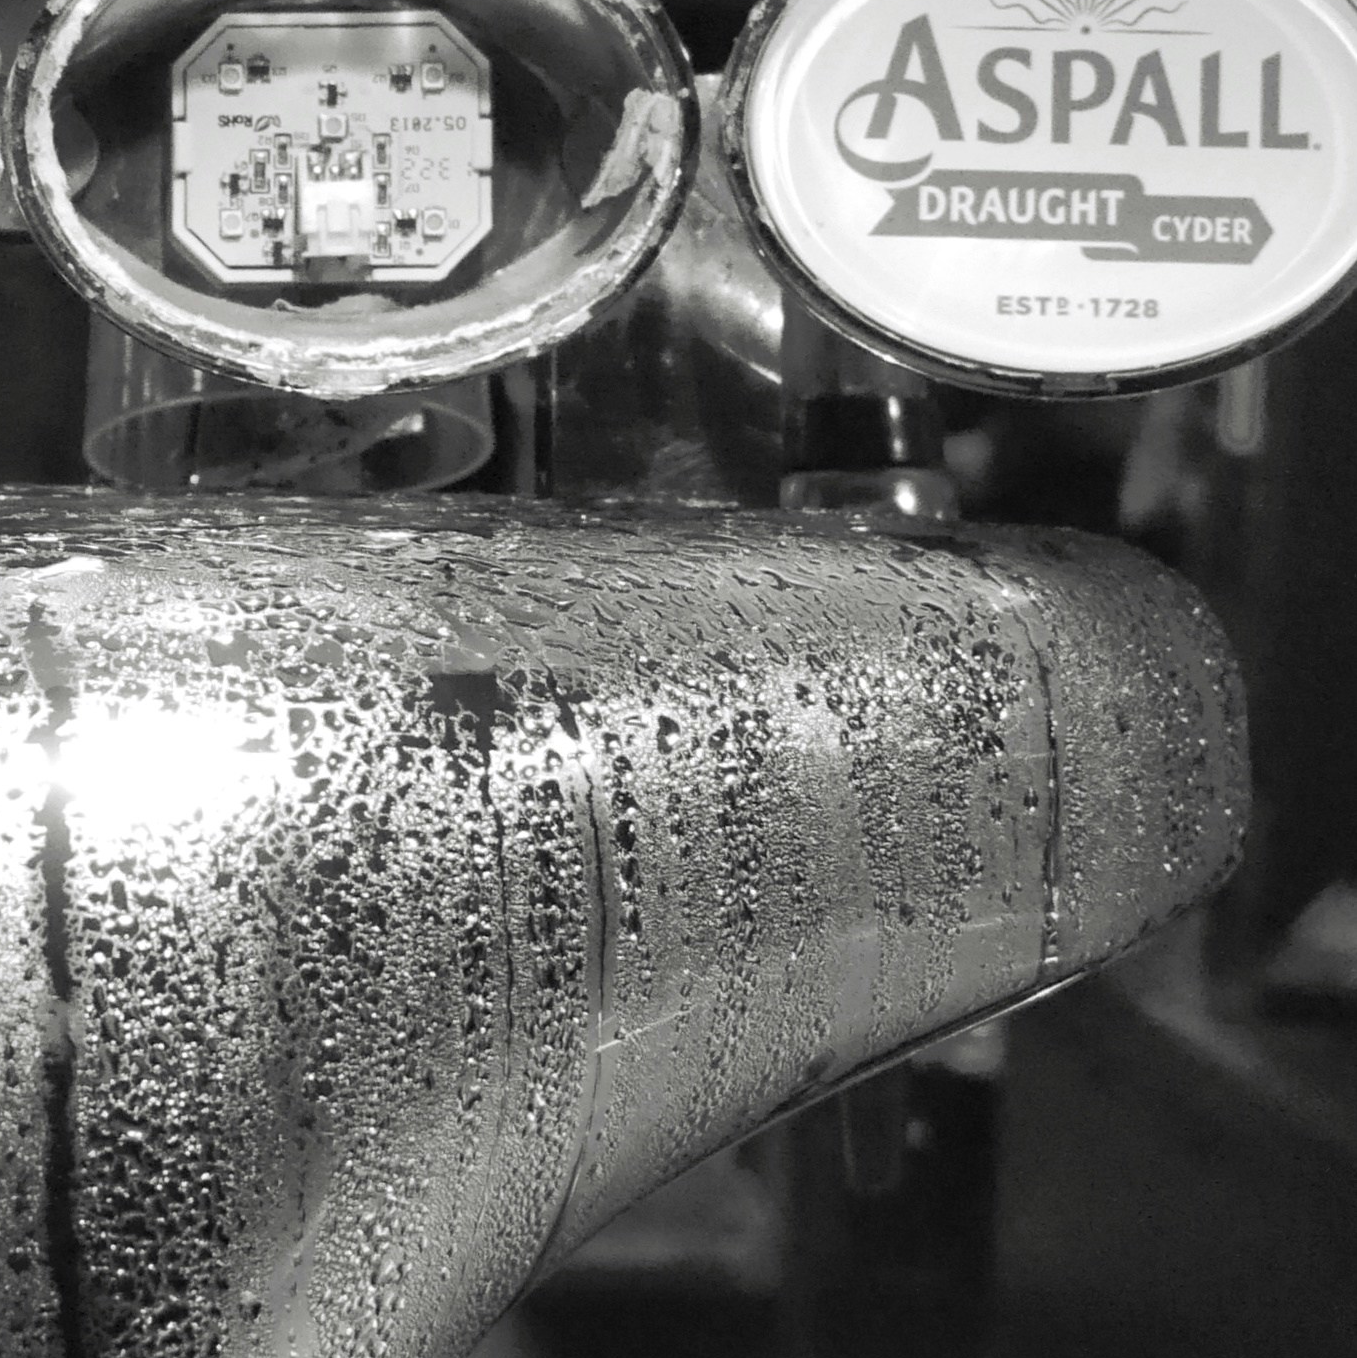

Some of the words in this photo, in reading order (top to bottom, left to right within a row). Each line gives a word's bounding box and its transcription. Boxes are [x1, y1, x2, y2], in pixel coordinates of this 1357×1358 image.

[390, 116, 466, 132] 05.2013
[834, 13, 1310, 184] ASPALL
[918, 186, 1125, 226] DRAUGHT
[1152, 215, 1252, 244] CYDER
